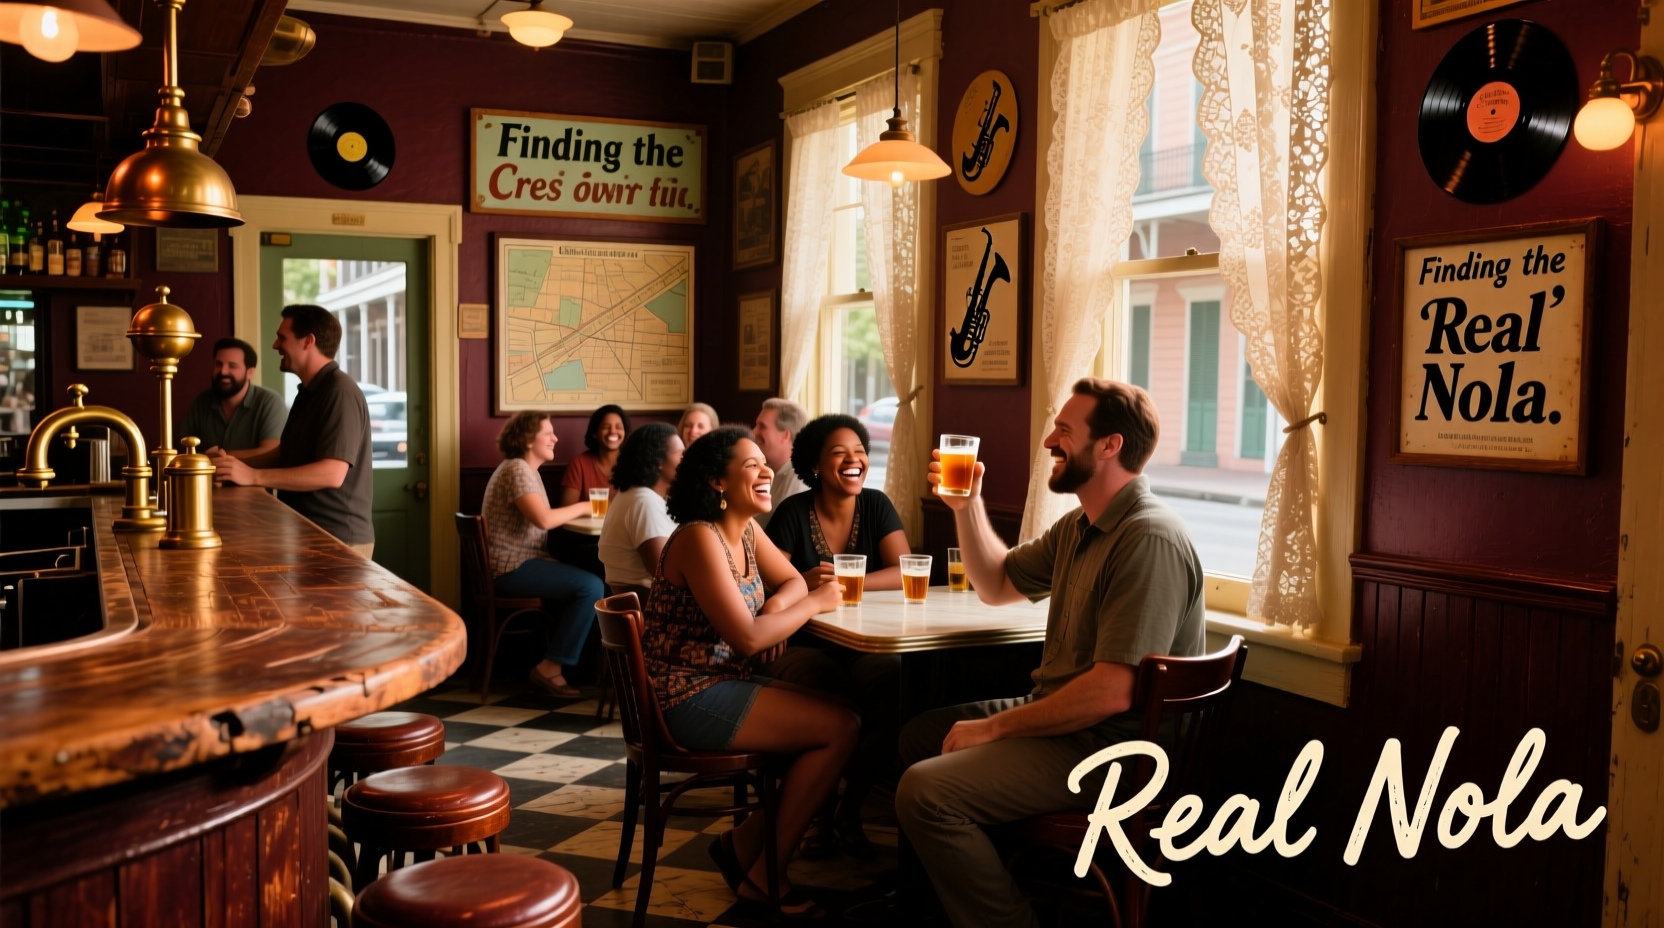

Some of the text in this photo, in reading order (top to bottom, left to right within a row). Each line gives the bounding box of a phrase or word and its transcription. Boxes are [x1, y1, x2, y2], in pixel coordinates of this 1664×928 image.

[497, 123, 684, 173] Finding the
[1419, 245, 1566, 288] Finding the
[1414, 361, 1562, 424] Nola.
